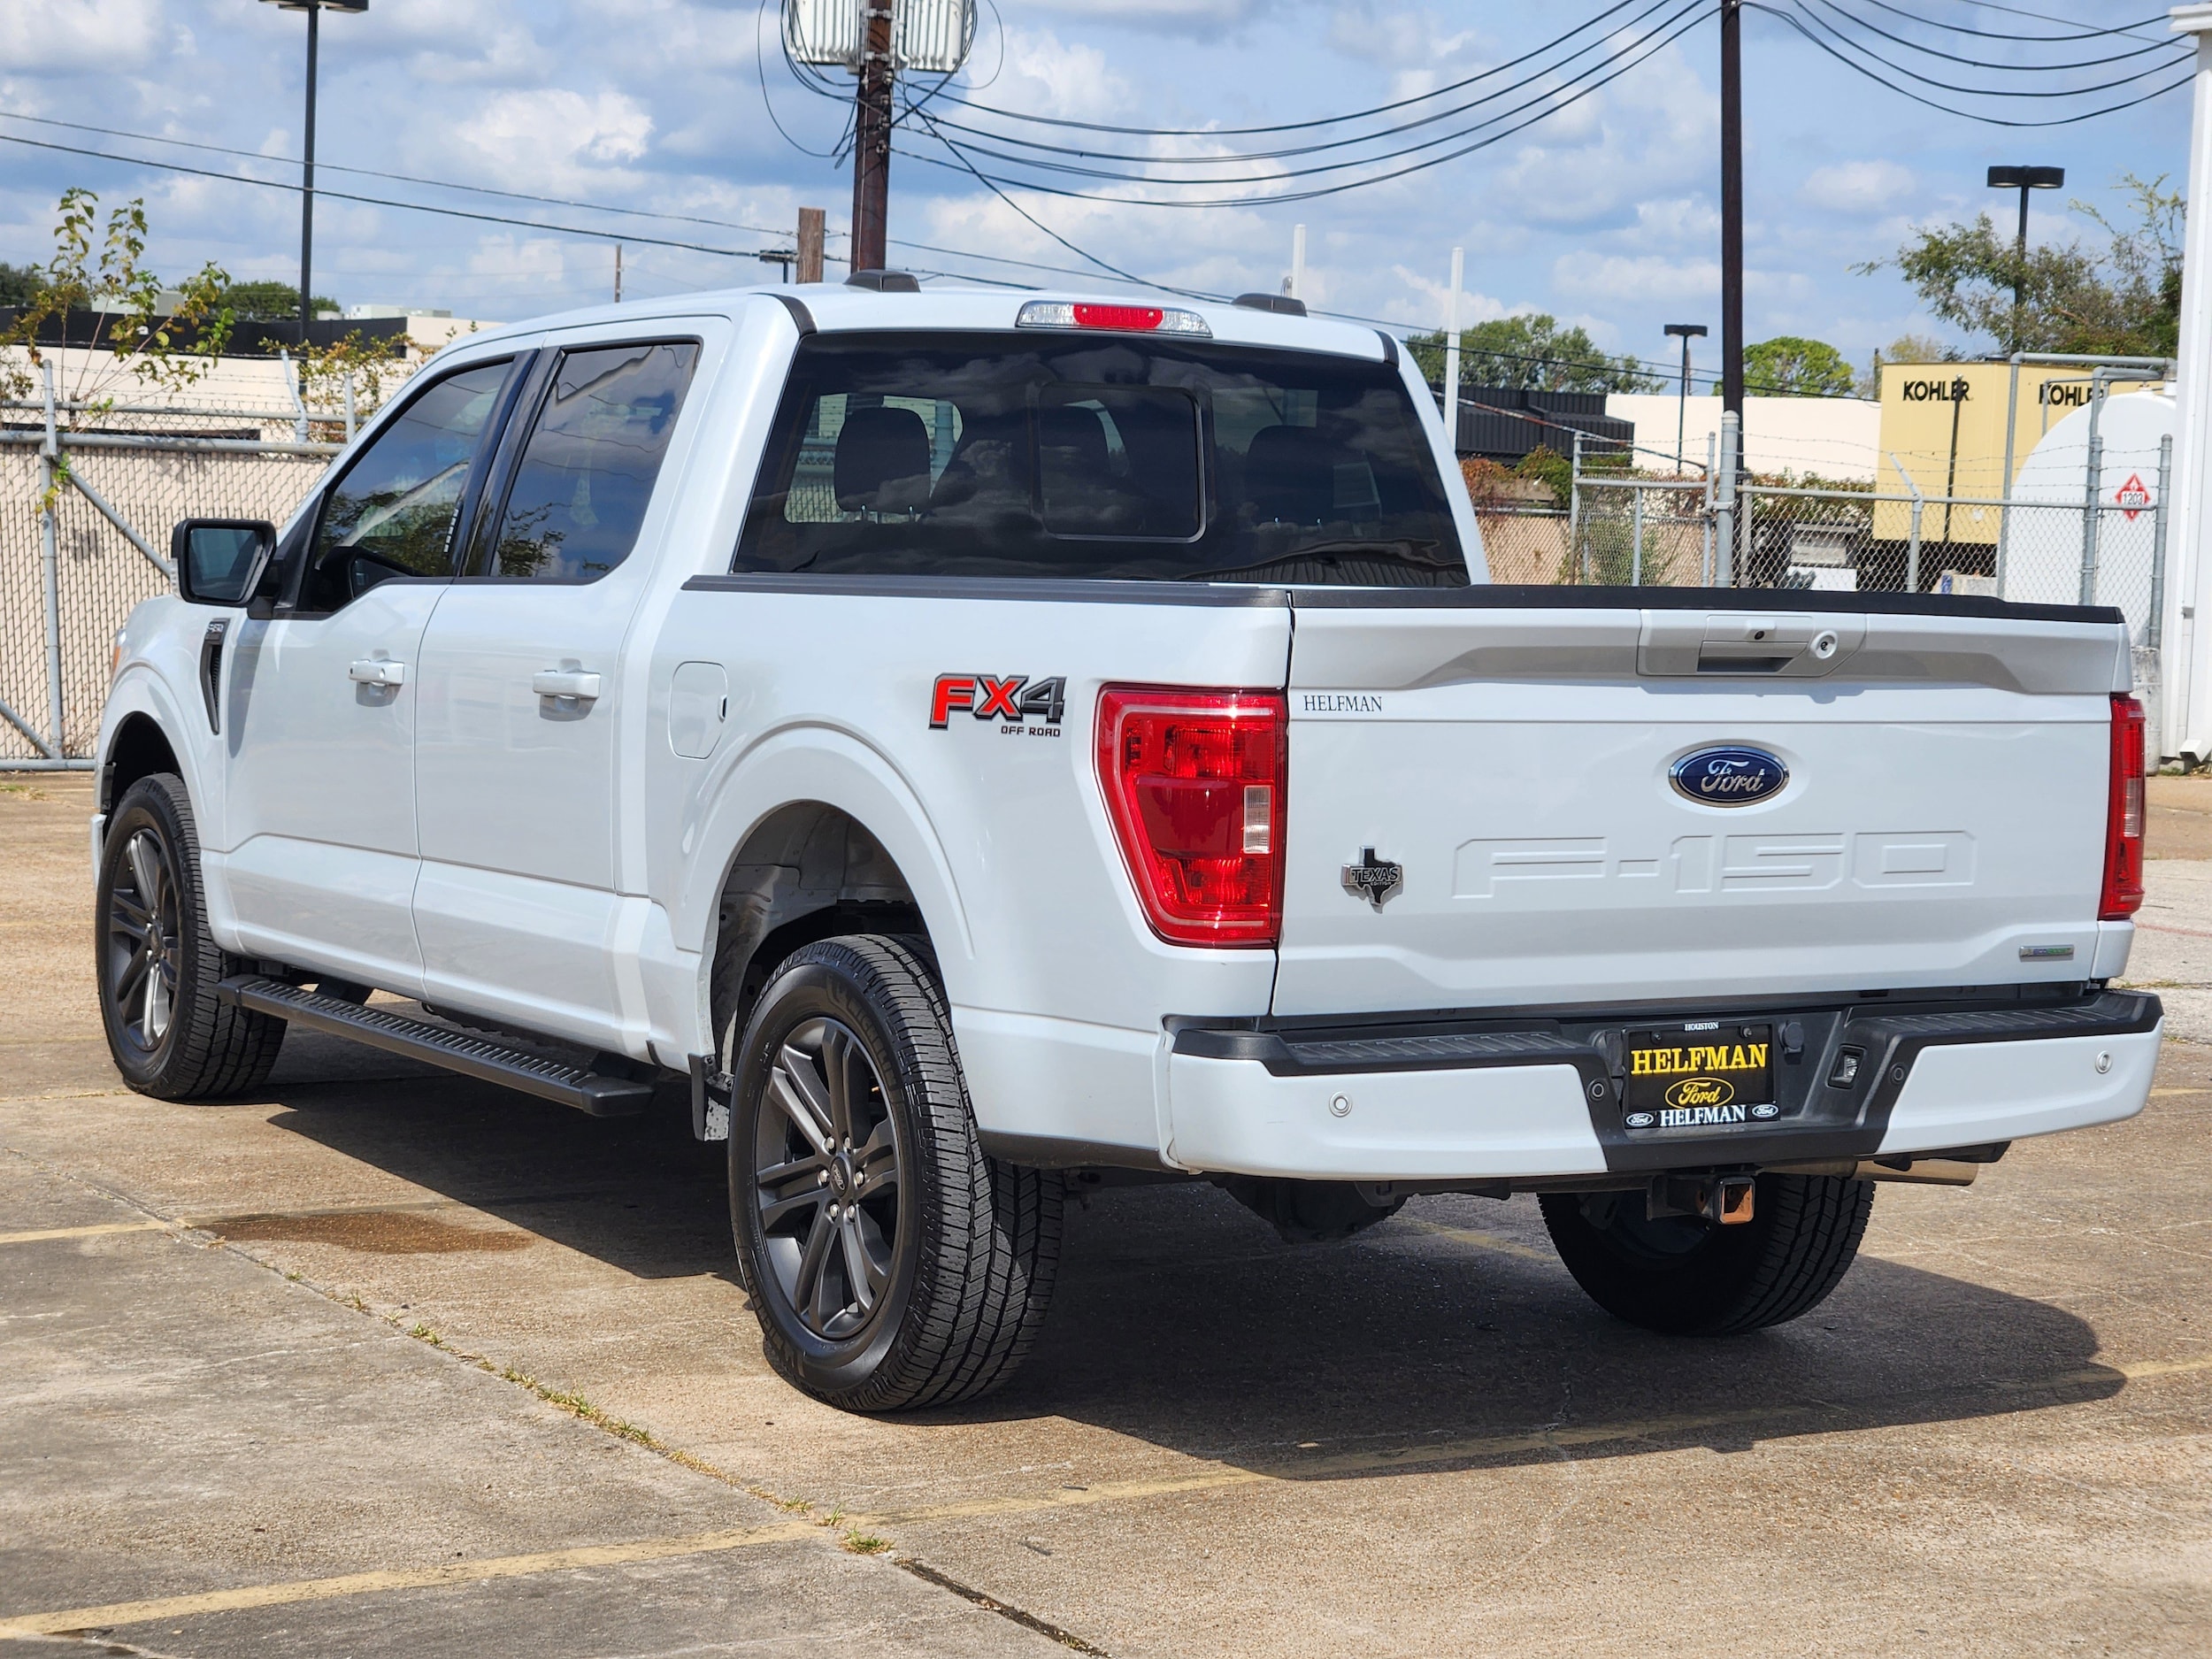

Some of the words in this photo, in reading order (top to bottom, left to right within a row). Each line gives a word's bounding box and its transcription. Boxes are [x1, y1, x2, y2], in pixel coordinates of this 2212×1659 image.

[1902, 380, 1970, 402] KOHLER
[2123, 492, 2144, 505] 1203
[928, 672, 1067, 731] FX4
[1302, 695, 1382, 712] HELFMAN
[1001, 726, 1025, 735] OFF
[1028, 726, 1061, 738] ROAD
[1701, 759, 1766, 793] Ford
[1350, 867, 1399, 882] TEXAS
[1452, 830, 1977, 899] F-150
[1684, 1022, 1719, 1032] HOUSTON
[1631, 1043, 1769, 1075] HELFMAN
[1678, 1081, 1722, 1105] Ford
[1659, 1105, 1747, 1127] HELFMAN
